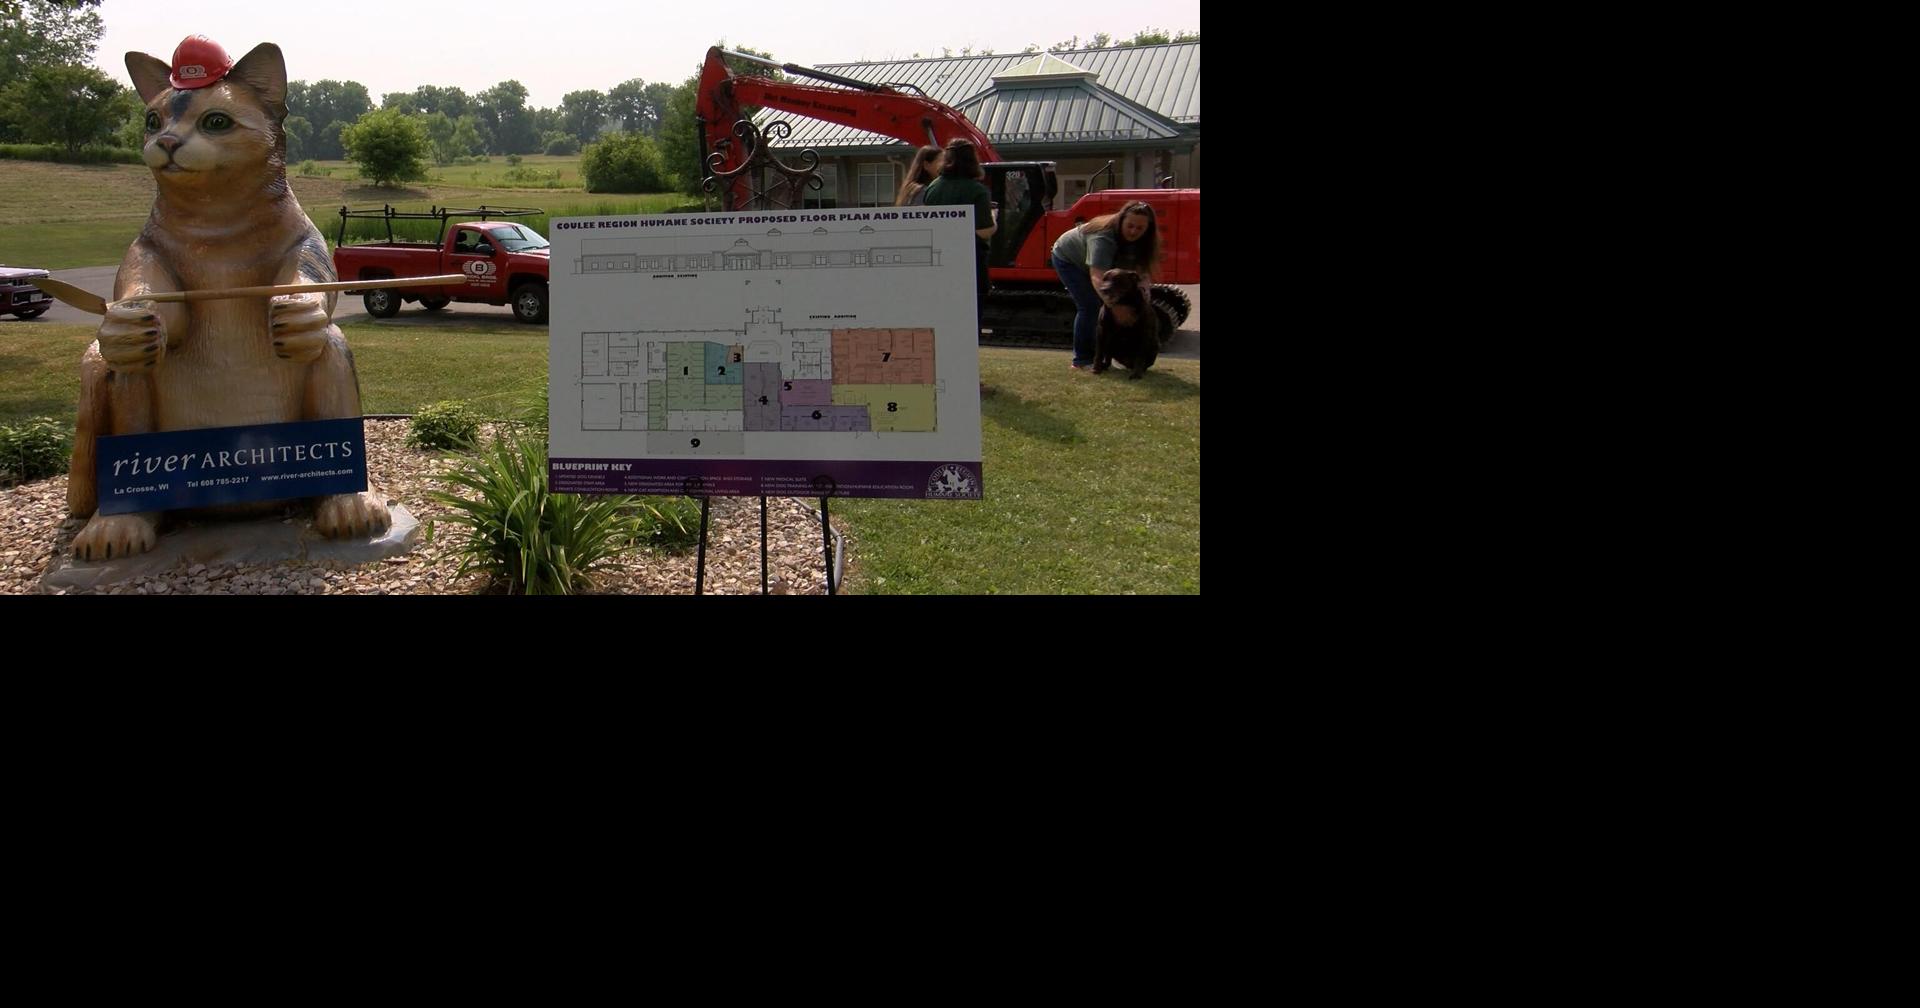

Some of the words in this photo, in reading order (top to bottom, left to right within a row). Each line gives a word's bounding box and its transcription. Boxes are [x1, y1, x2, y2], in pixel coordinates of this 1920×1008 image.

[557, 222, 596, 230] COULEE
[598, 220, 638, 229] REGION
[640, 218, 688, 228] HUMANE
[690, 217, 735, 226] SOCIETY
[738, 215, 797, 225] PROPOSED
[800, 213, 836, 222] FLOOR
[839, 212, 870, 221] PLAN
[873, 211, 899, 220] AND
[902, 210, 966, 220] ELEVATION
[733, 353, 742, 363] 3
[881, 352, 892, 363] 7
[683, 366, 689, 376] 1
[717, 366, 726, 376] 2
[783, 381, 793, 391] 5
[758, 395, 769, 406] 4
[887, 402, 898, 413] 8
[811, 410, 822, 420] 6
[690, 438, 701, 448] 9
[113, 451, 197, 477] river
[201, 441, 353, 469] ARCHITECTS
[552, 463, 609, 471] BLUEPRINT
[611, 463, 633, 471] KEY
[261, 467, 353, 482] www.river-architects.com
[187, 480, 199, 488] Tel
[200, 479, 214, 487] 608
[216, 476, 250, 486] 785-2217
[114, 487, 125, 496] La
[126, 485, 157, 495] Crosse,
[158, 483, 169, 491] WI
